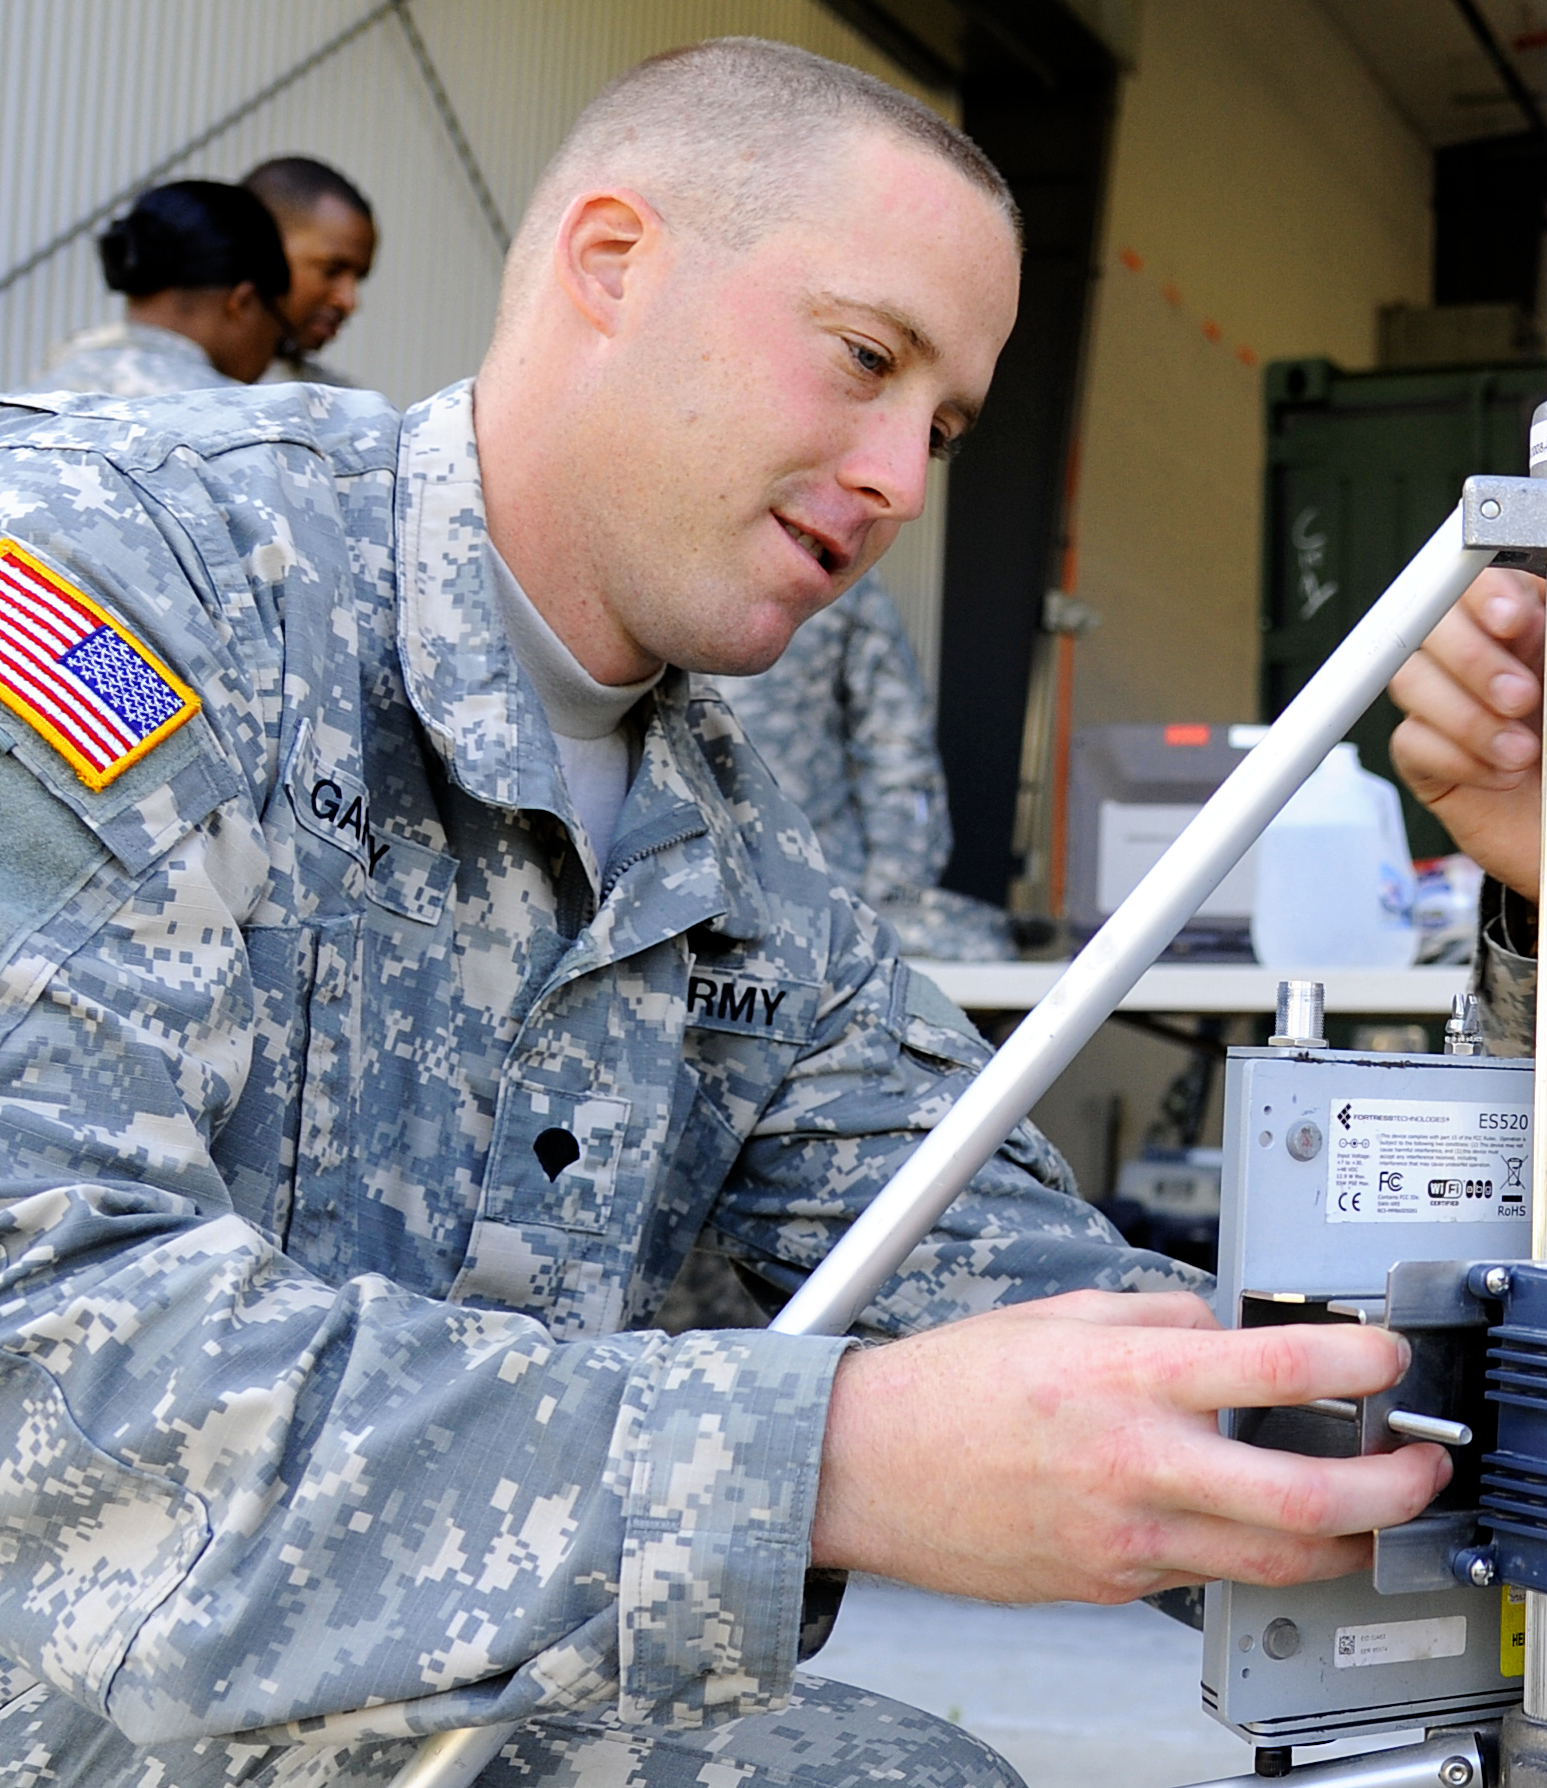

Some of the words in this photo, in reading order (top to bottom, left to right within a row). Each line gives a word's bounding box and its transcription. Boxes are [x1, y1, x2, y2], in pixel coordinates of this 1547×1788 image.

[687, 976, 786, 1026] RMY
[1479, 1113, 1529, 1130] ES520
[1498, 1205, 1526, 1217] RoHS
